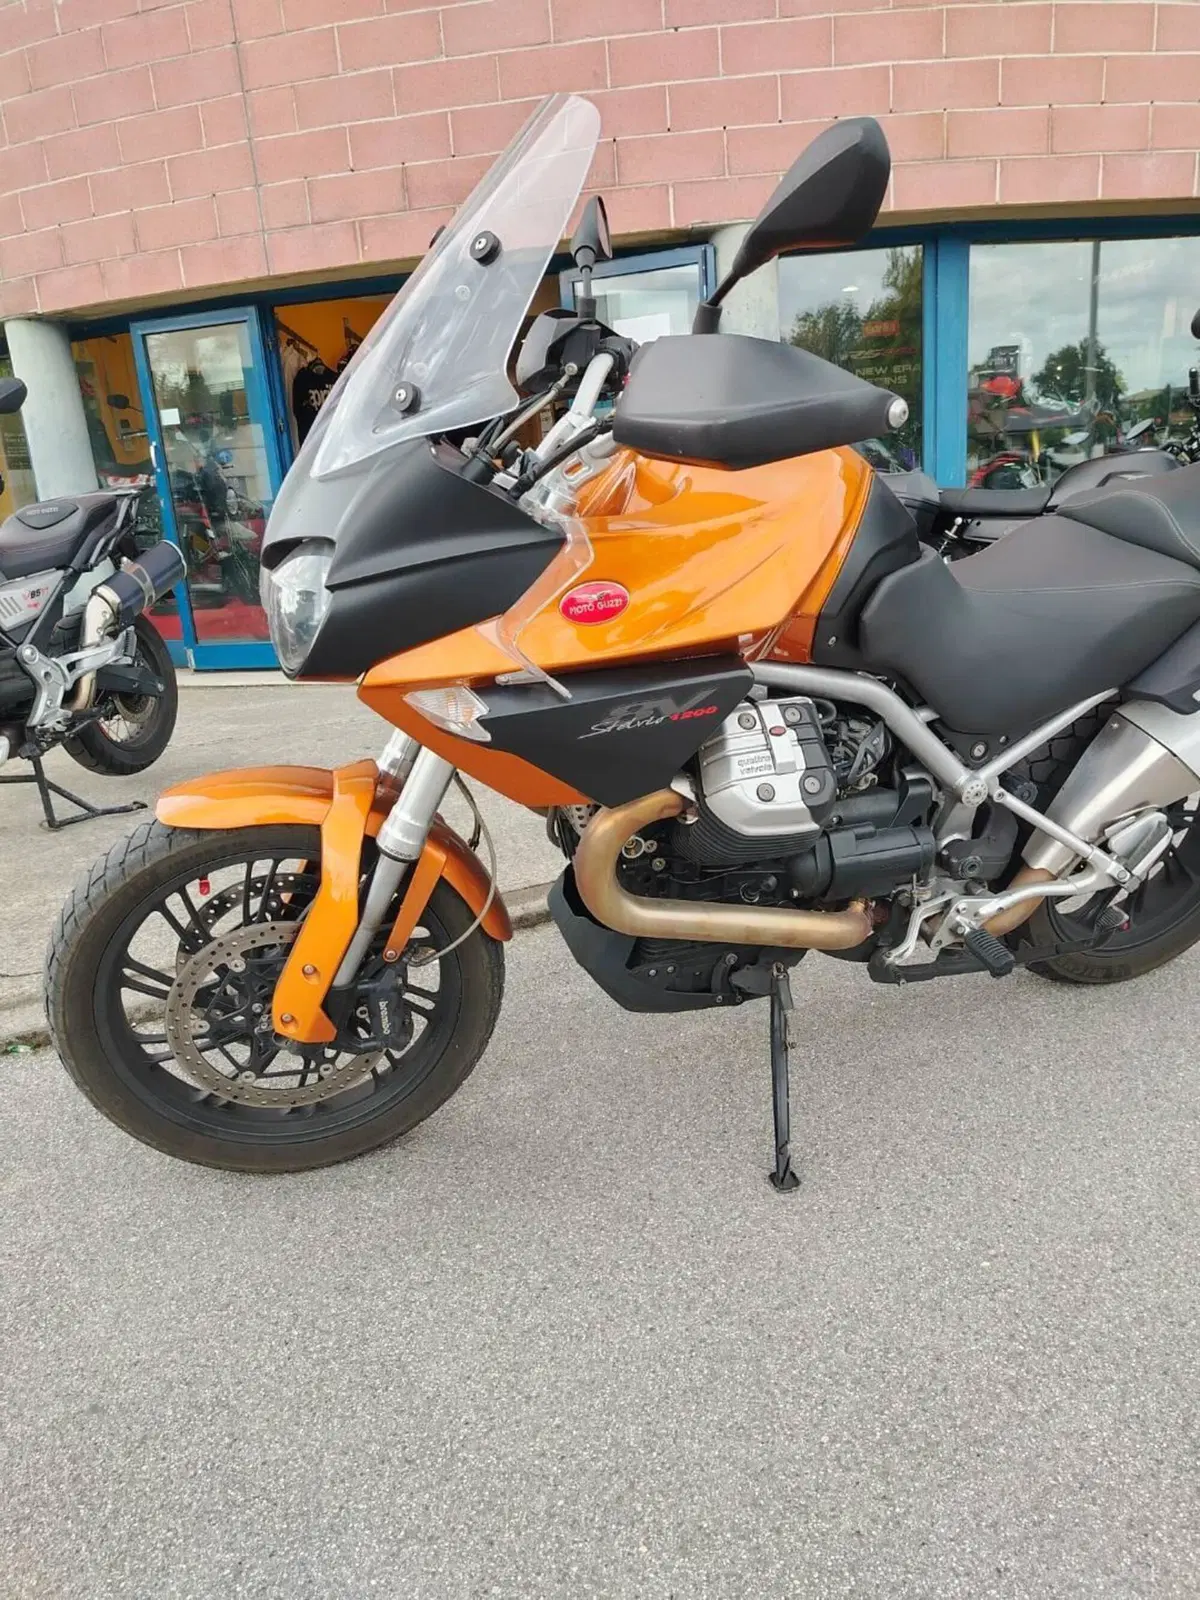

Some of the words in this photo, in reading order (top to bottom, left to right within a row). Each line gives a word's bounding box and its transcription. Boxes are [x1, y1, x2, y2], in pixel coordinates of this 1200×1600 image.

[855, 366, 888, 376] NEW
[569, 602, 595, 615] MOTO
[597, 599, 623, 610] GUZZI
[669, 705, 718, 721] 1200
[379, 1000, 391, 1035] brembo
